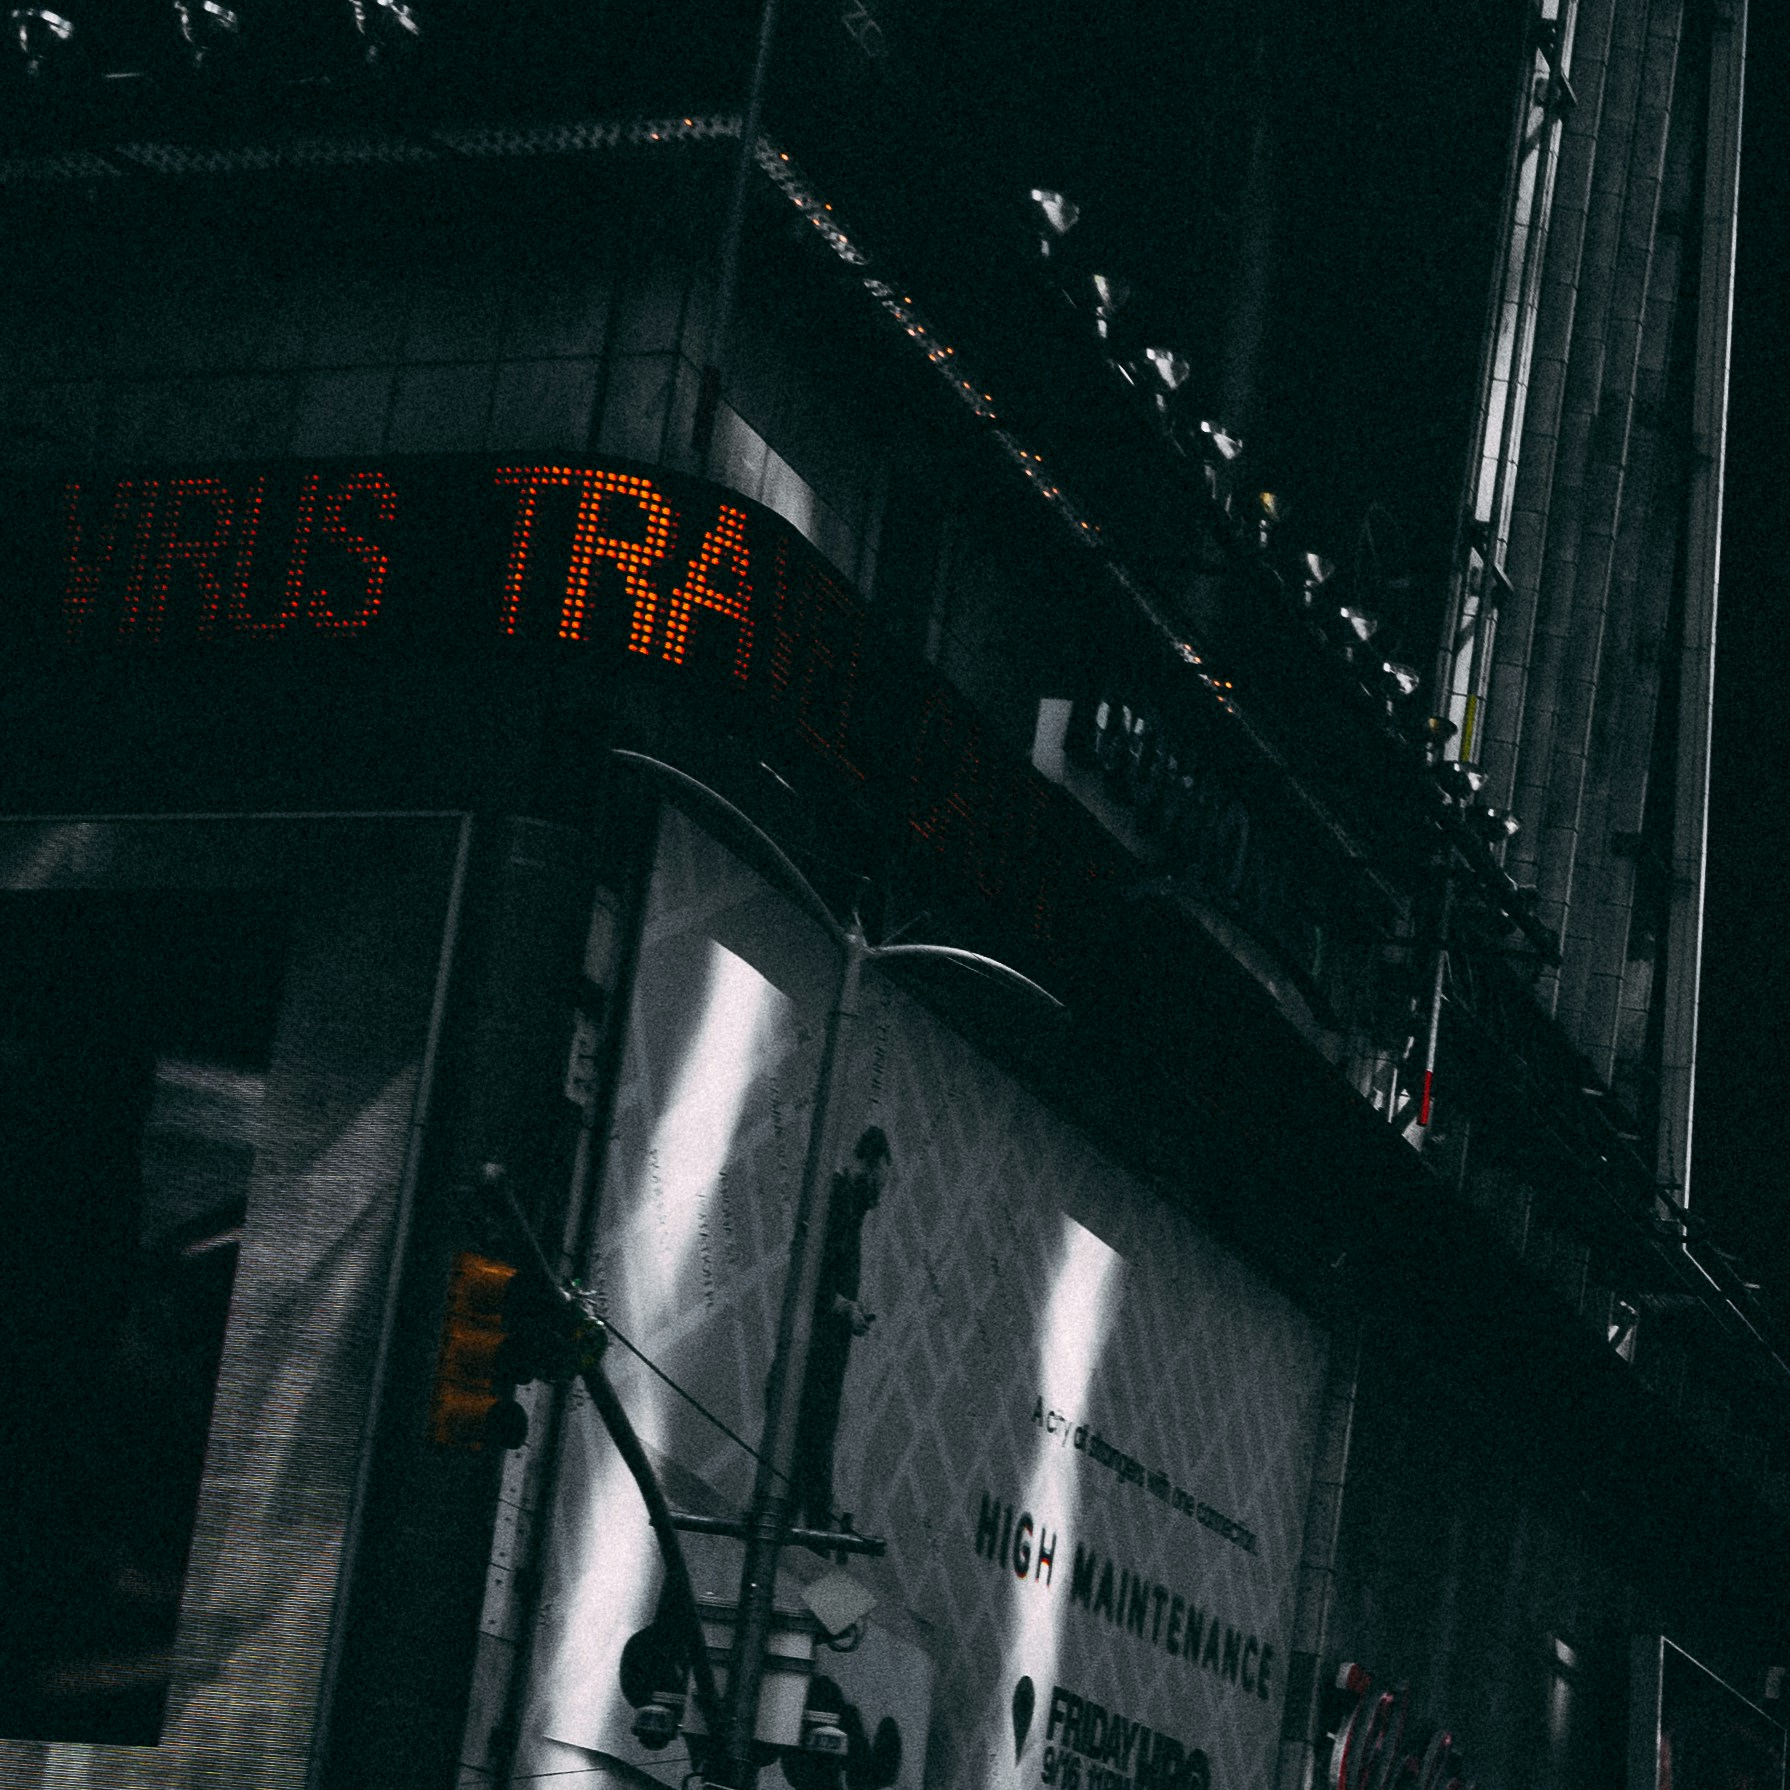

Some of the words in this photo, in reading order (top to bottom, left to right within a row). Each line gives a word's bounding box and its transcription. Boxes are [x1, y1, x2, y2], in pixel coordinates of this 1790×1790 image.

[62, 470, 397, 643] VIRUS
[976, 1494, 1055, 1587] HIGH
[1069, 1550, 1273, 1699] MAINTENANCE
[1041, 1745, 1080, 1788] 9/16
[1047, 1687, 1134, 1760] FRIDAY
